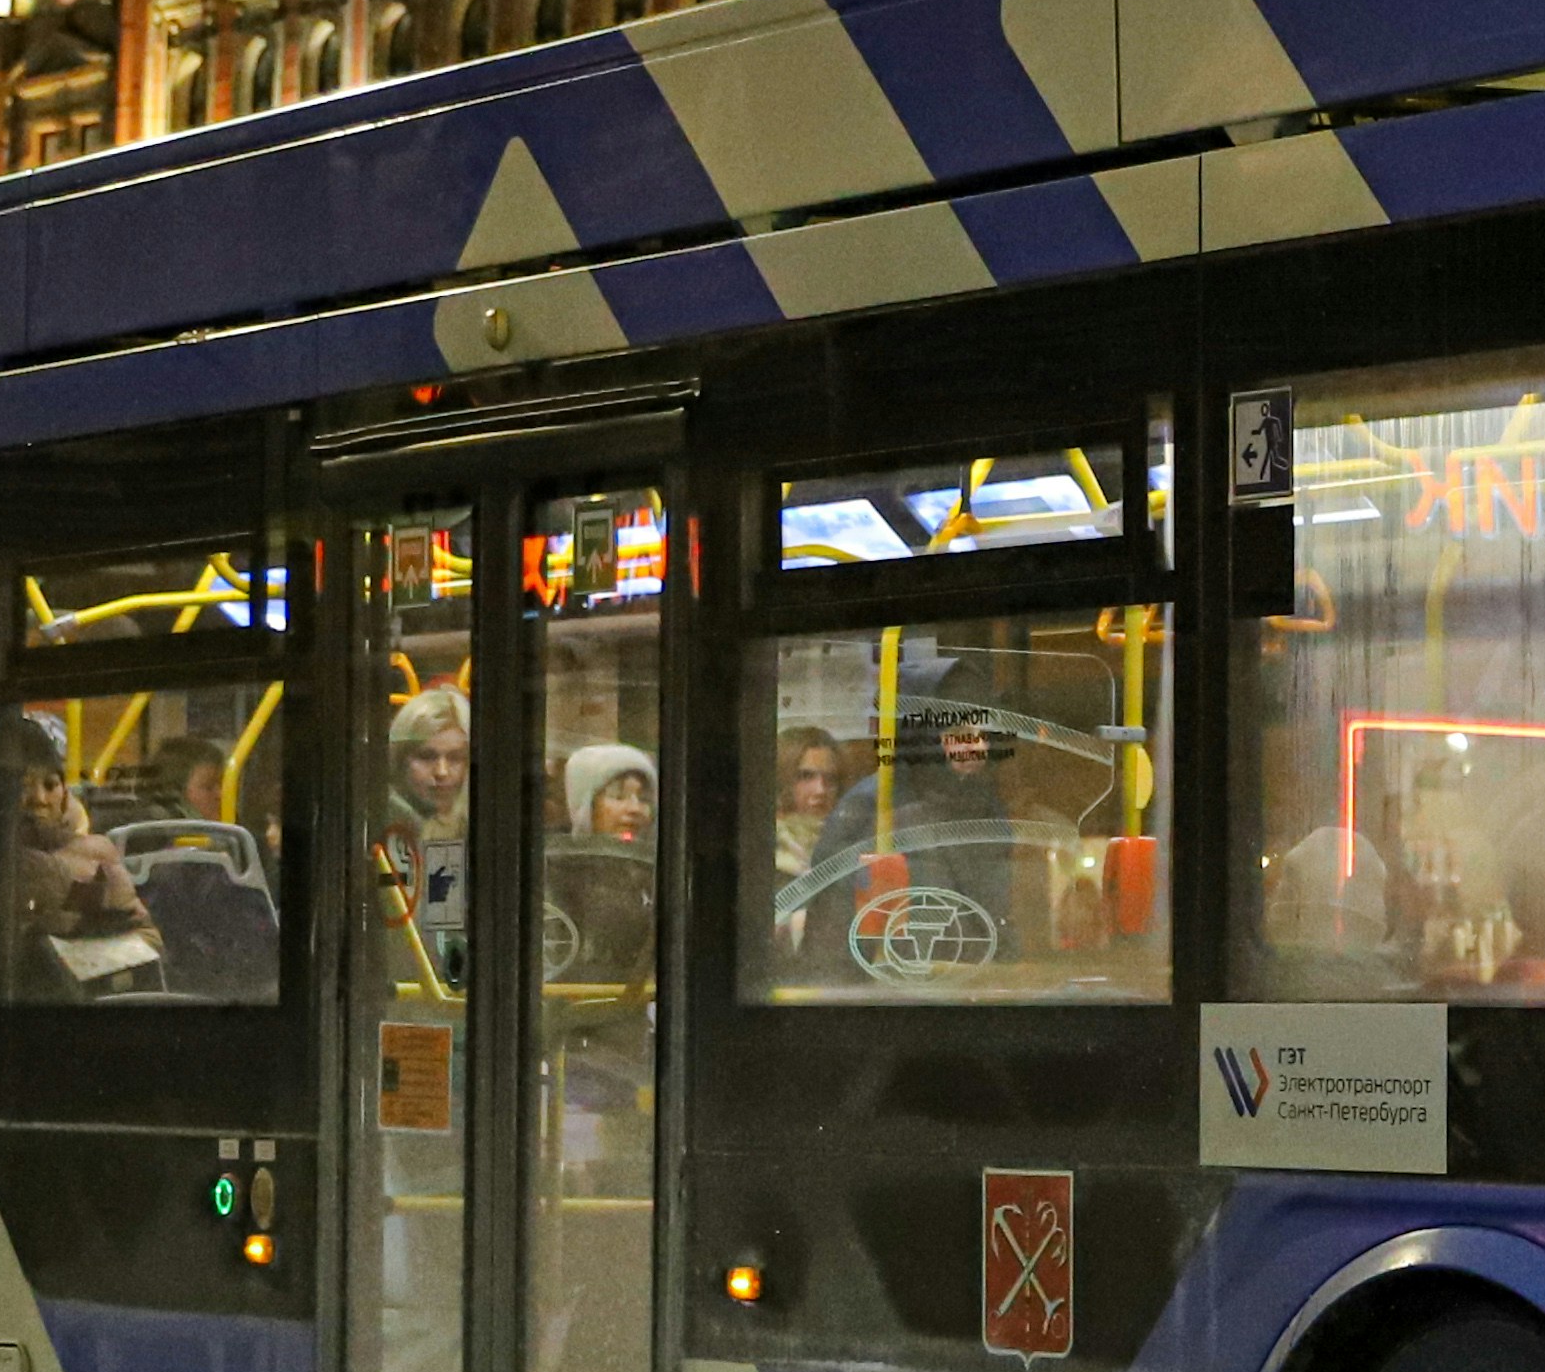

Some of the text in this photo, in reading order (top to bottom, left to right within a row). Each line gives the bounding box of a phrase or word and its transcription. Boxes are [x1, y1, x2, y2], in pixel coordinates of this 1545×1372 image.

[1278, 1047, 1307, 1065] ГЭТ
[1278, 1074, 1432, 1097] Электротранспорт
[1277, 1101, 1428, 1126] Санкт-Петербурга
